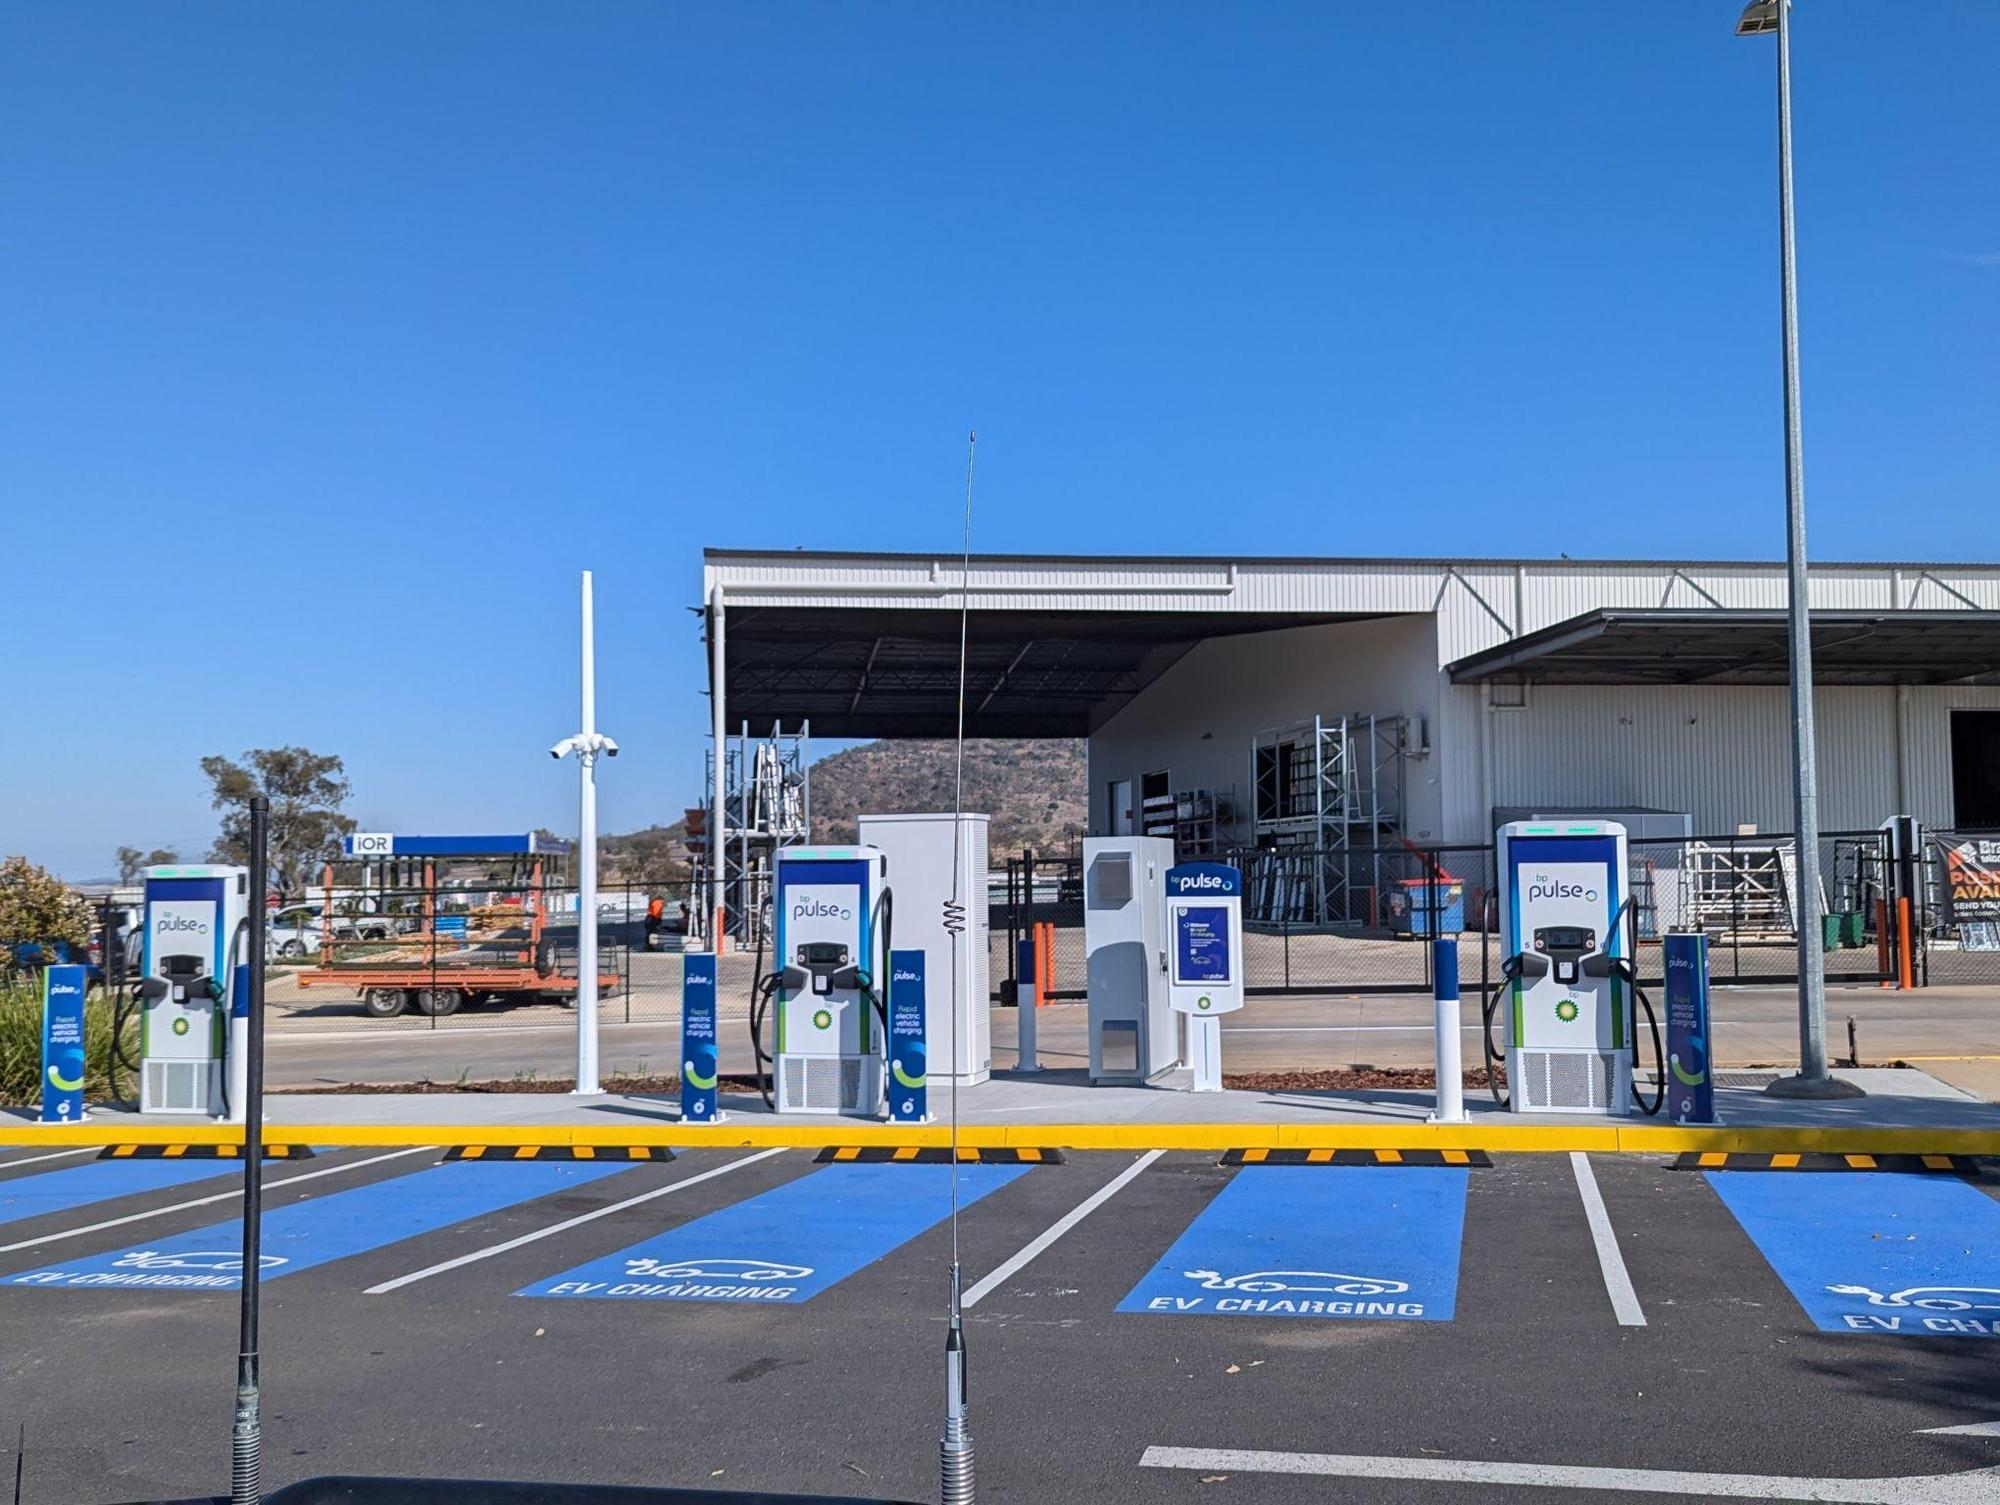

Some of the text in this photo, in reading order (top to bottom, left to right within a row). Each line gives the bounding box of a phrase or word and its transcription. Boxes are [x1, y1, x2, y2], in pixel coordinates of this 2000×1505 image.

[1180, 873, 1222, 892] pulse
[1536, 874, 1548, 883] bp
[1529, 880, 1583, 902] pulse
[800, 895, 811, 903] bp
[794, 901, 839, 921] pulse
[1953, 902, 1979, 910] SEND
[158, 916, 197, 934] pulse
[1668, 958, 1688, 968] pulse
[687, 975, 708, 985] pulse
[893, 971, 916, 982] pulse
[51, 985, 75, 995] pulse
[1569, 991, 1579, 999] bp
[686, 1030, 713, 1038] charging
[893, 1027, 922, 1036] charging
[14, 1272, 243, 1286] EV CHARGING
[547, 1282, 797, 1299] EV CHARGING
[1149, 1297, 1424, 1316] EV CHARGING
[1843, 1315, 1900, 1330] EV
